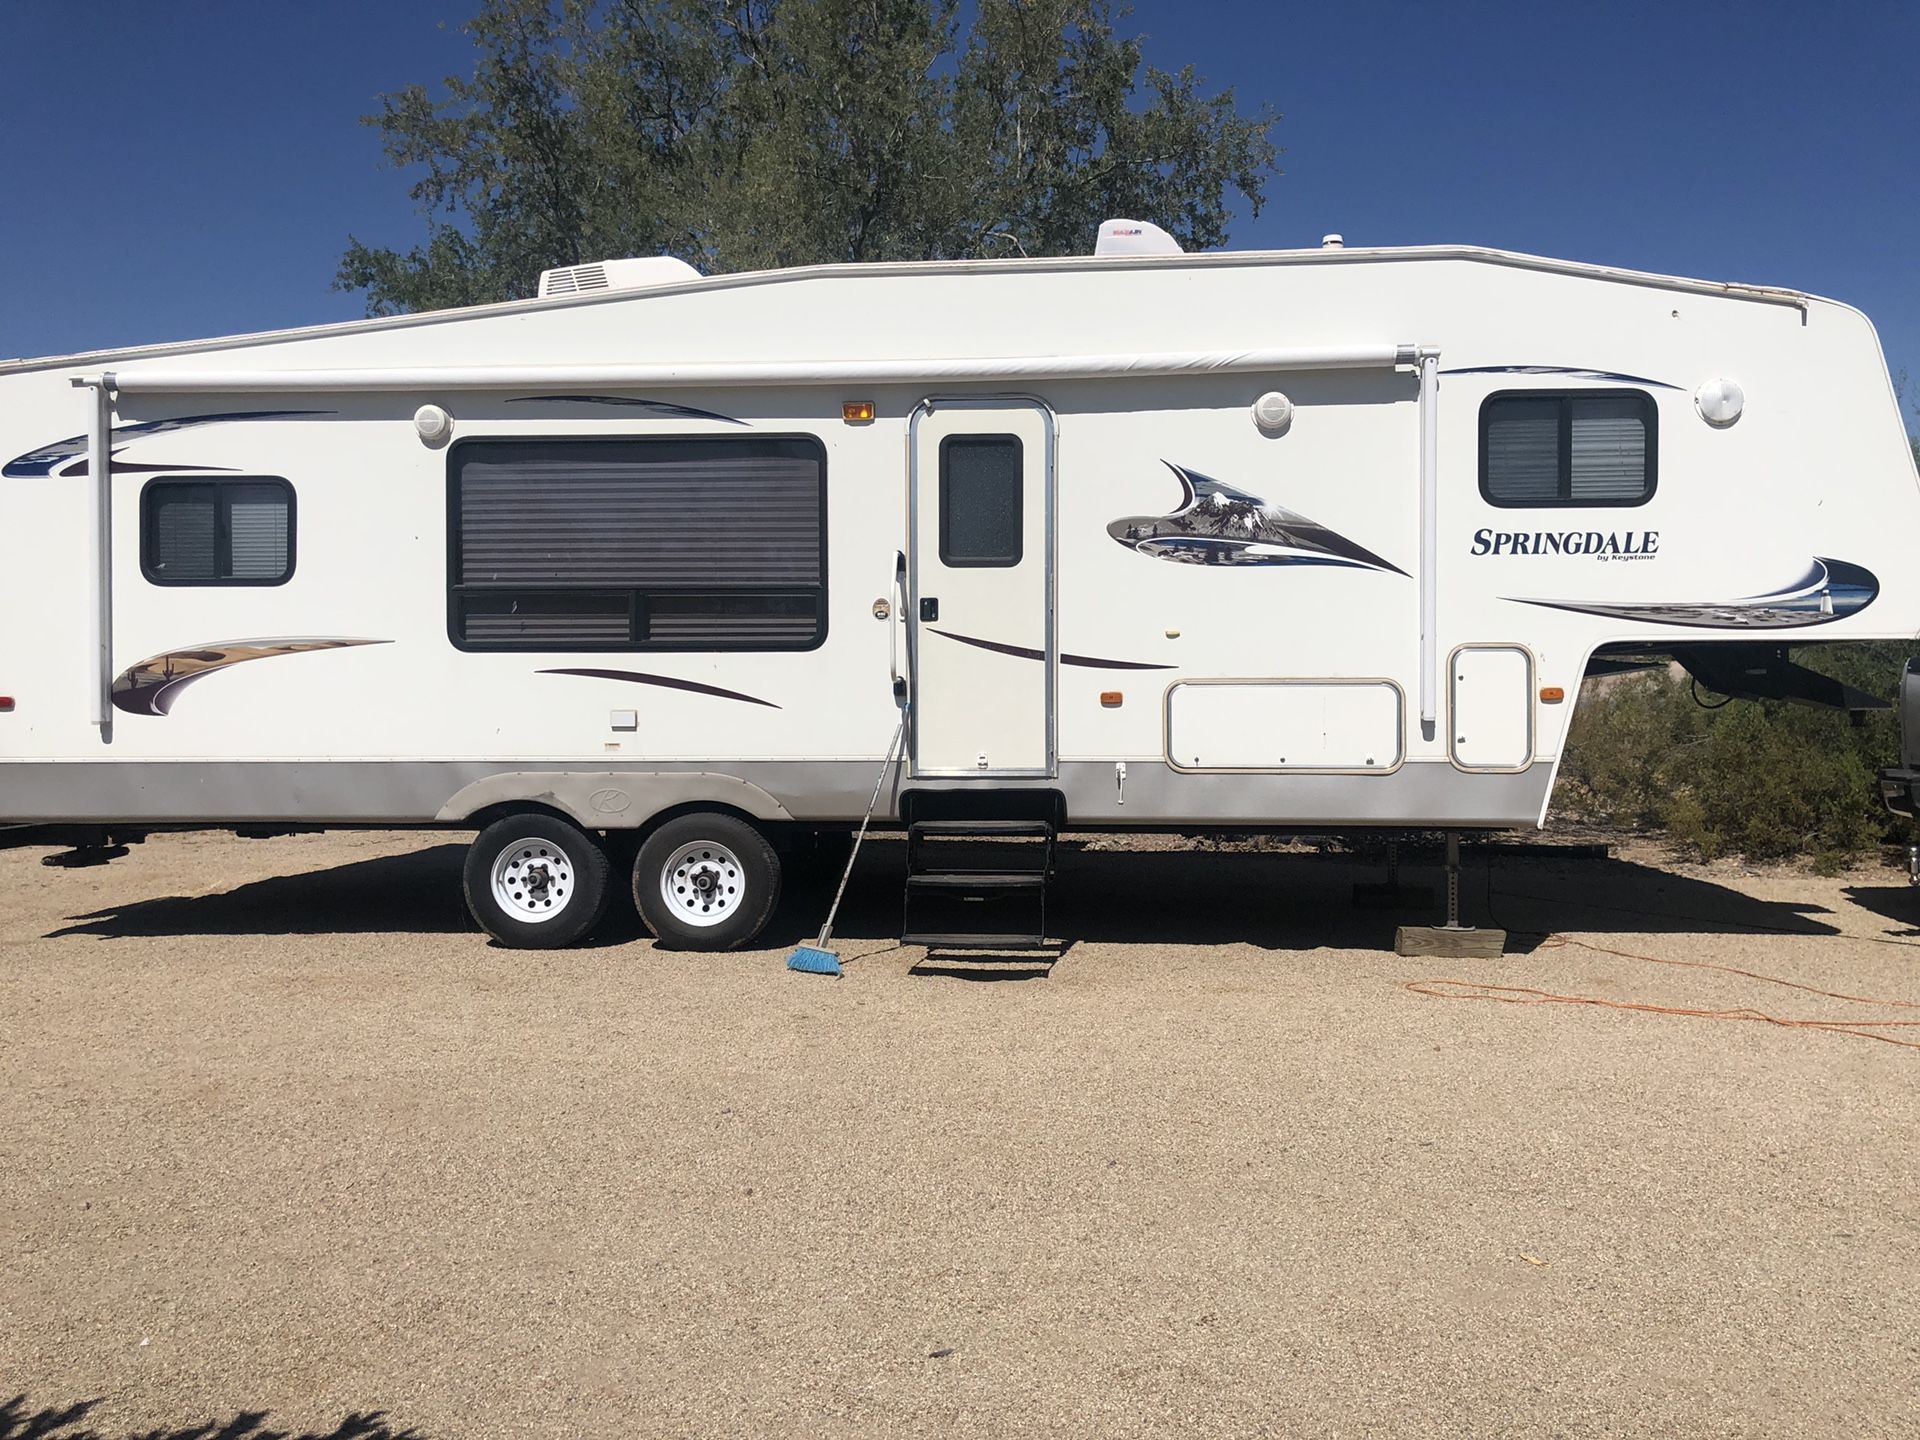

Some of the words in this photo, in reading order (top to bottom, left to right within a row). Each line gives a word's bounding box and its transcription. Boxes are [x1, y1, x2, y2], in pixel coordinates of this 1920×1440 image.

[1470, 528, 1660, 556] SPRINGDALE
[1596, 554, 1609, 563] by
[1611, 554, 1656, 562] Keystone
